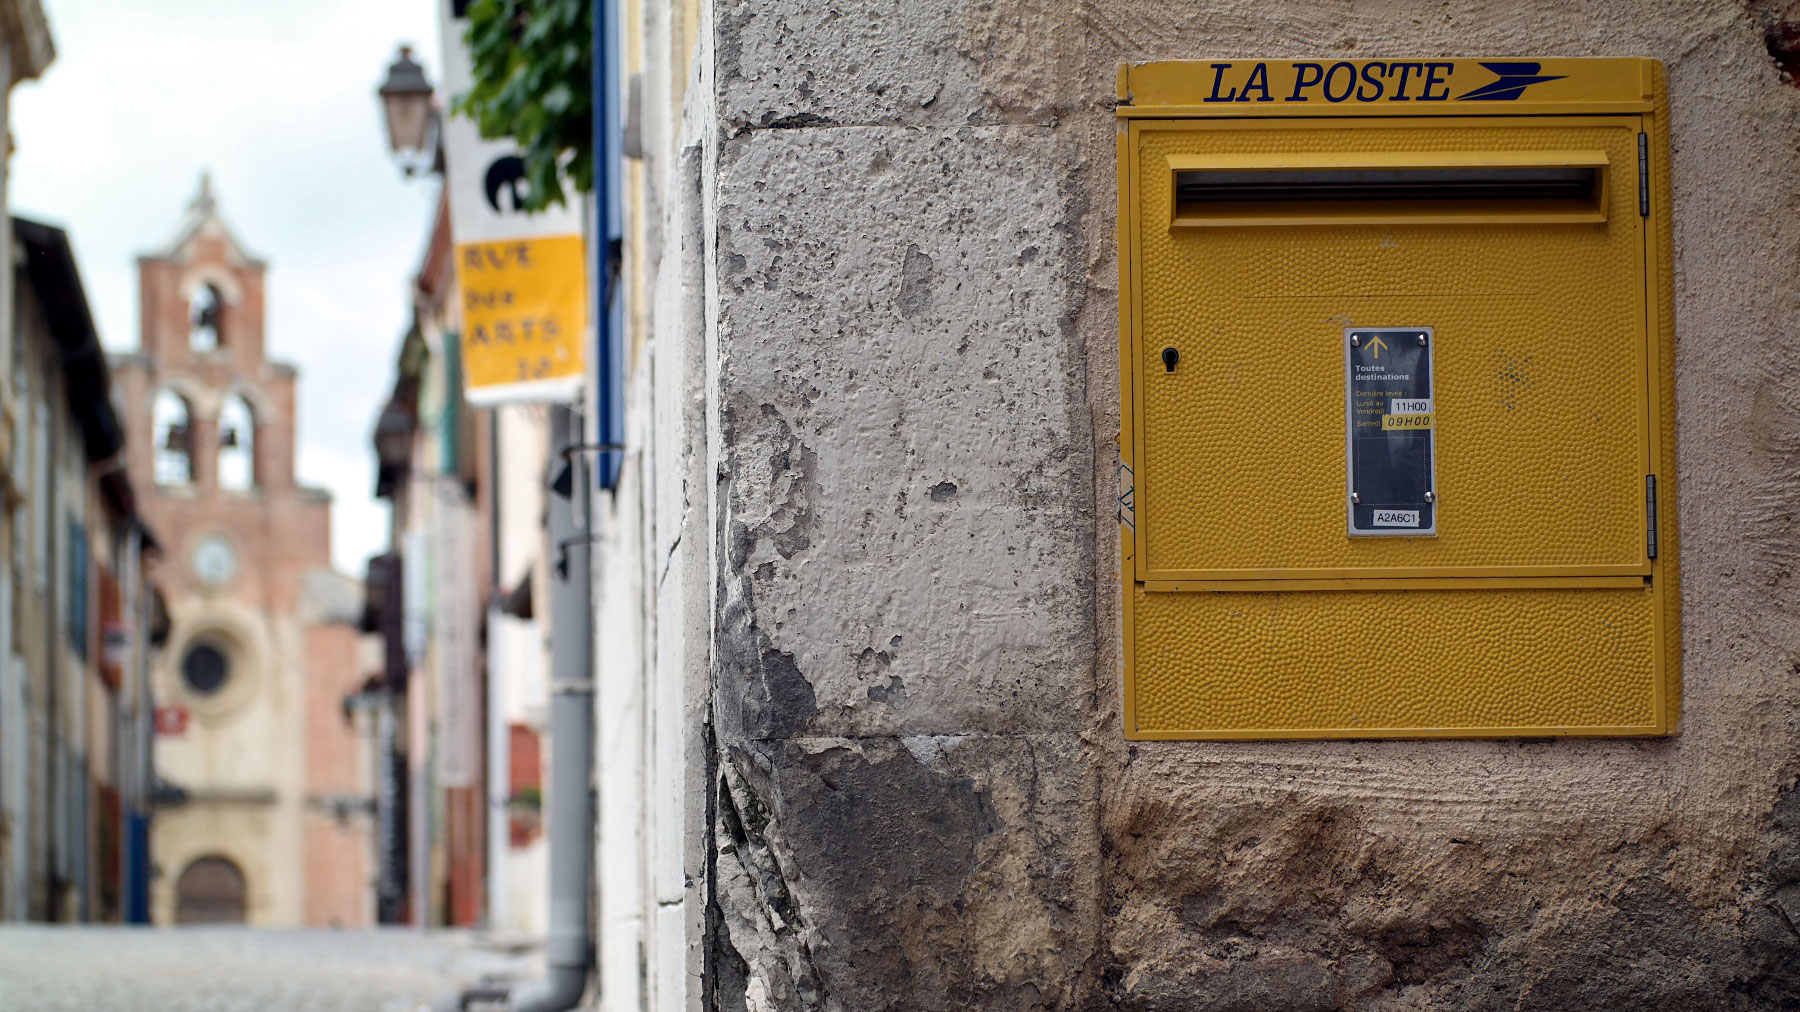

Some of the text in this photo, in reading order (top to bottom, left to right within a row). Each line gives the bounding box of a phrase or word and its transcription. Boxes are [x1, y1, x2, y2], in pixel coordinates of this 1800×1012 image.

[1203, 62, 1454, 103] LA POSTE
[1396, 402, 1427, 412] 11H00
[1388, 416, 1430, 426] 09H00
[1377, 513, 1416, 522] A2A6C1
